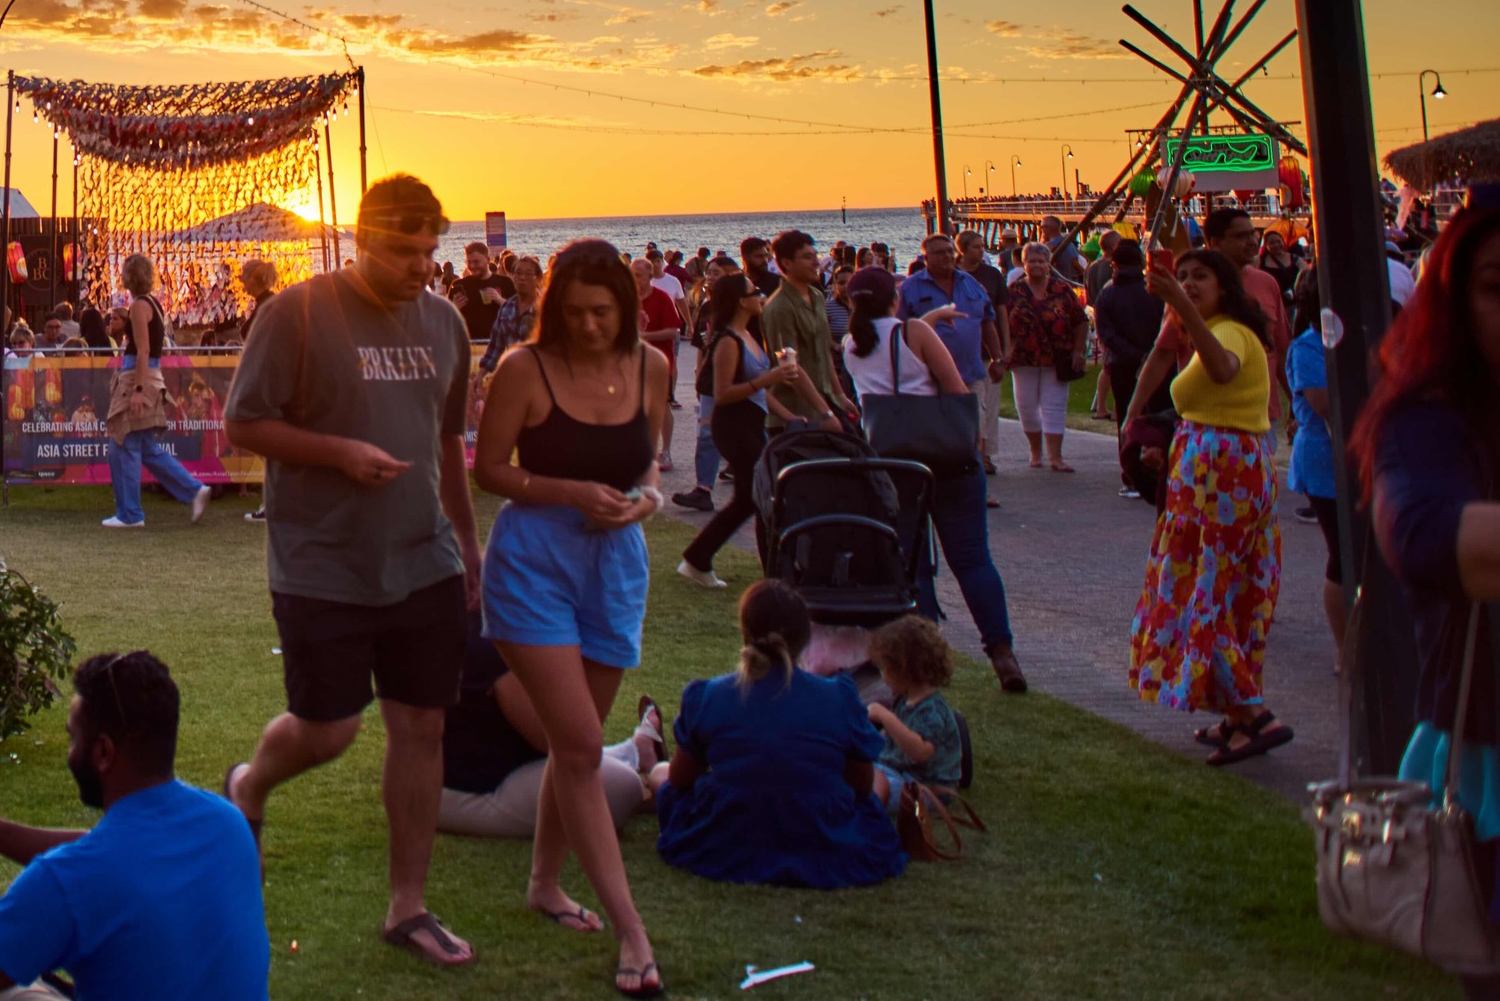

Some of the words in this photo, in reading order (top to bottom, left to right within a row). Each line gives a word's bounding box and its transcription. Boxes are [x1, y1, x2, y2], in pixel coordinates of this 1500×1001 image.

[357, 346, 437, 380] BRKLYN
[22, 422, 74, 433] CELEBRATING
[74, 421, 98, 432] ASIAN
[37, 445, 60, 458] ASIA
[62, 444, 98, 457] STREET
